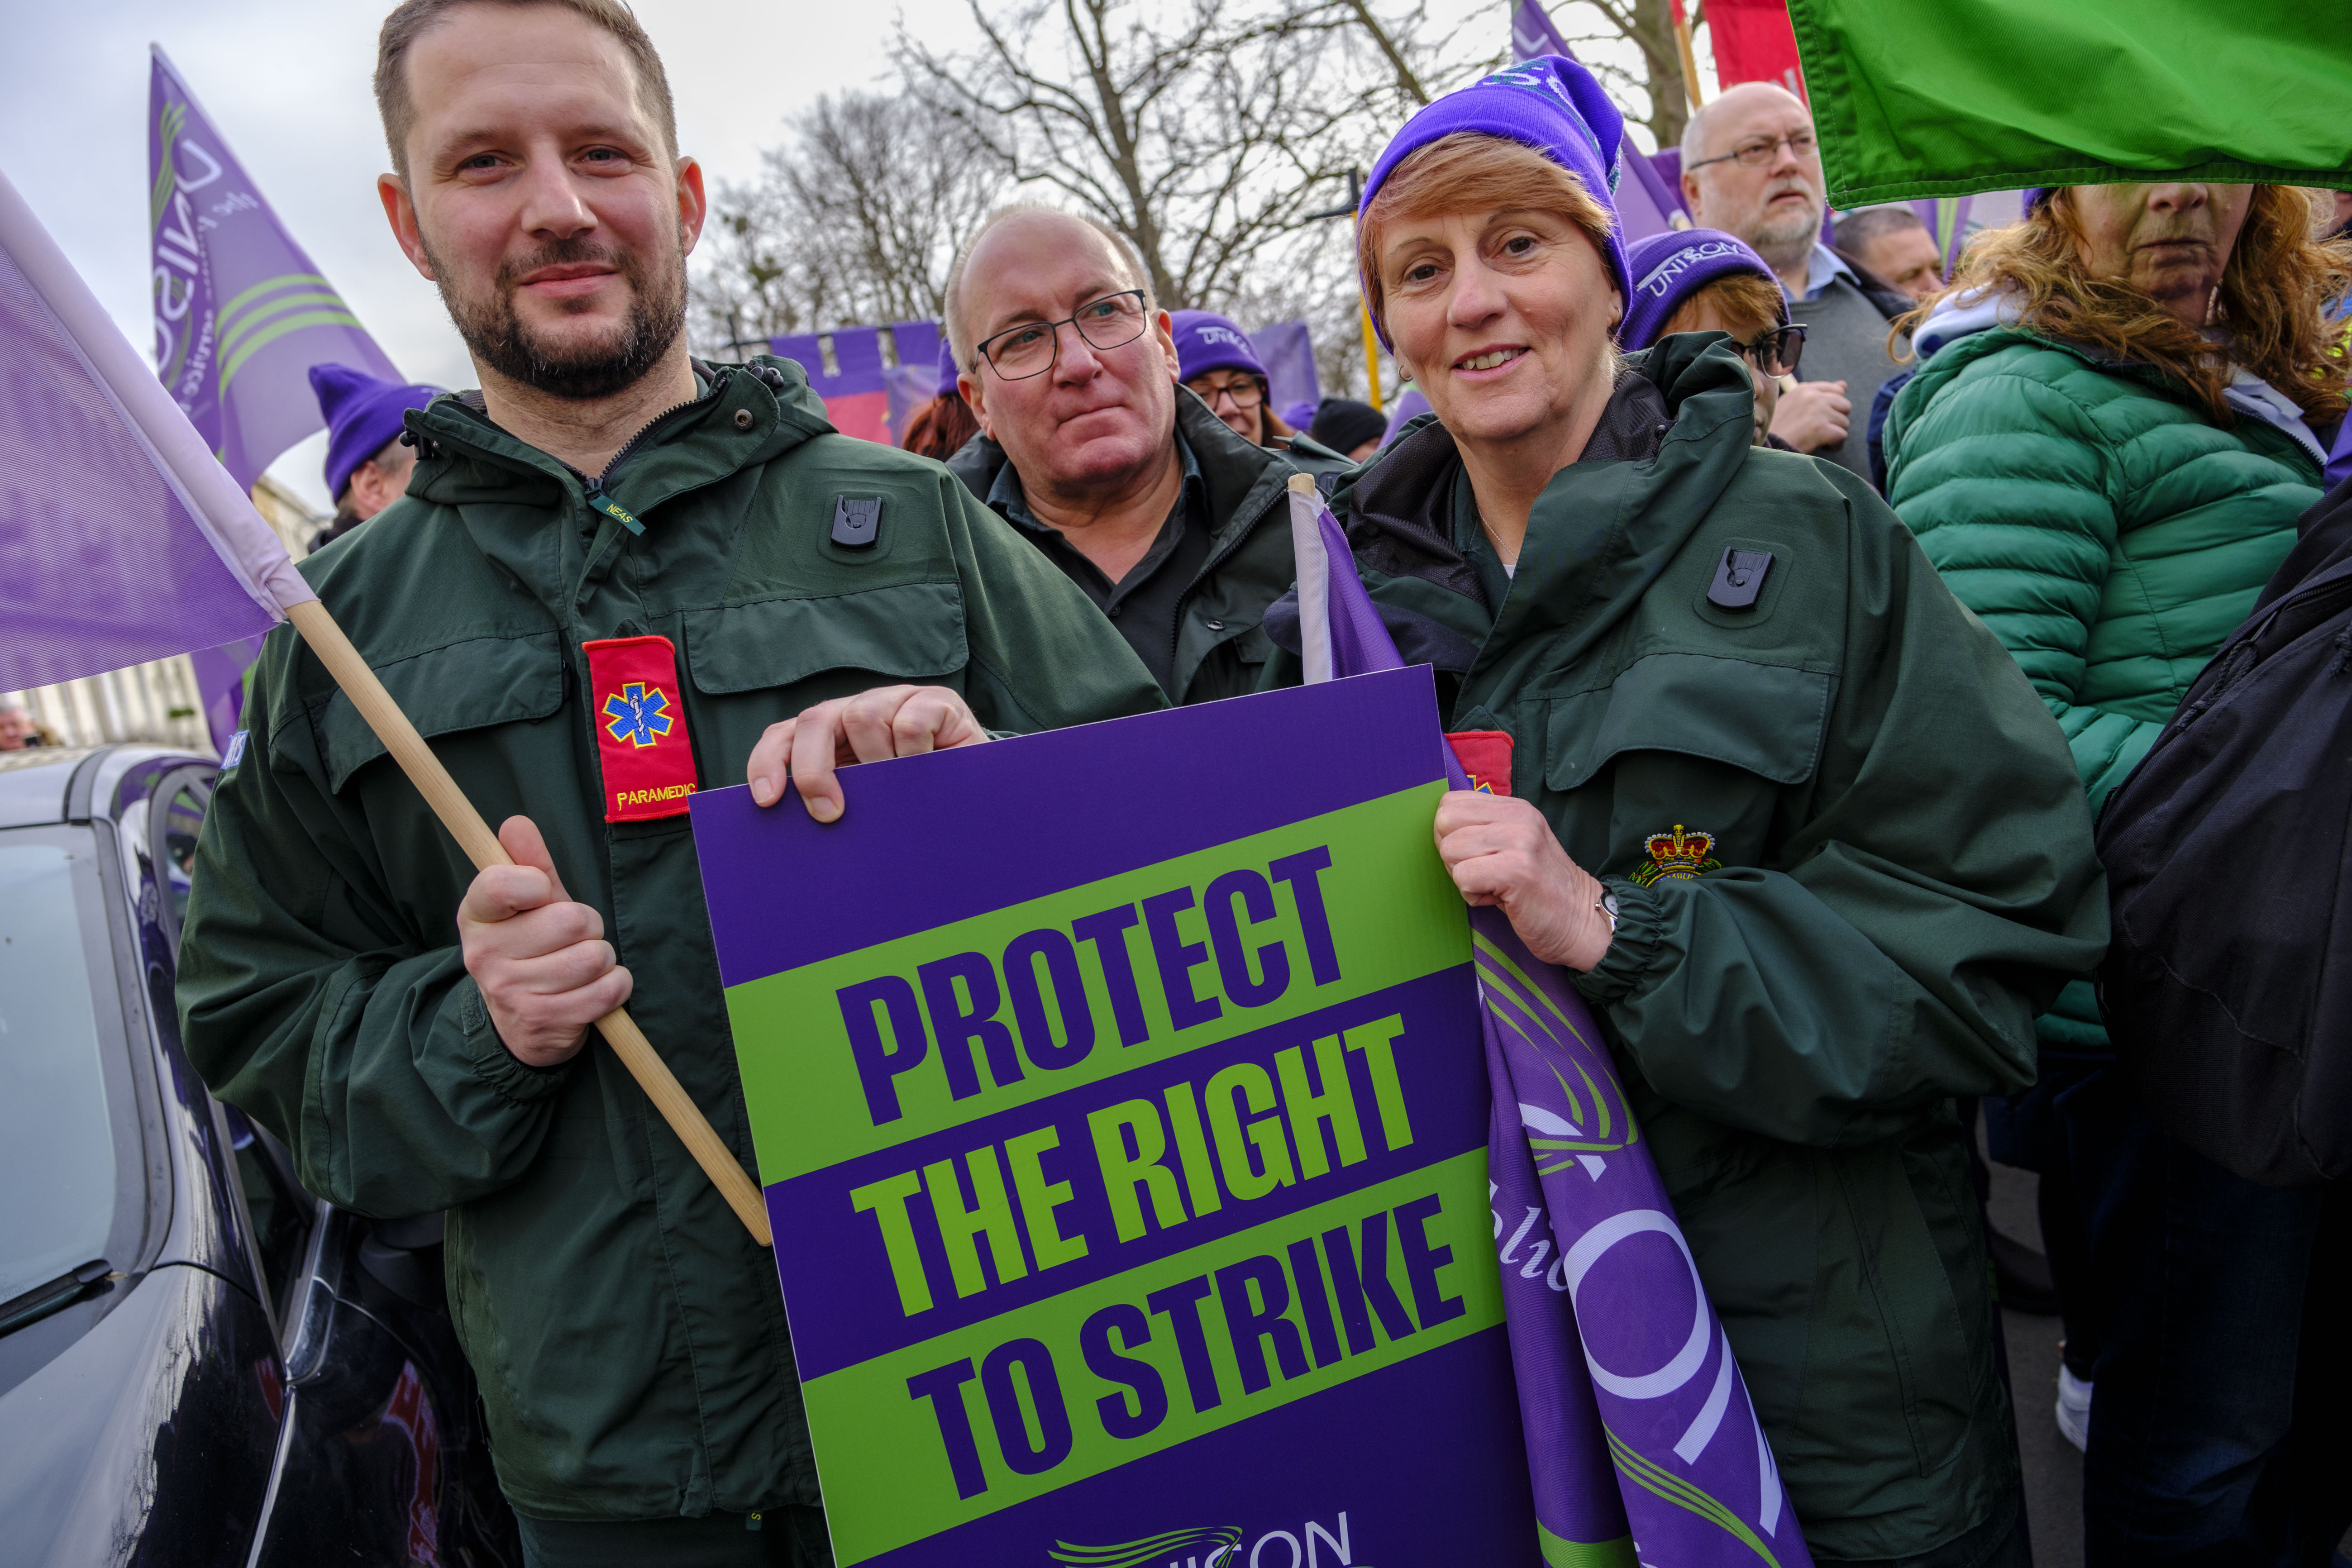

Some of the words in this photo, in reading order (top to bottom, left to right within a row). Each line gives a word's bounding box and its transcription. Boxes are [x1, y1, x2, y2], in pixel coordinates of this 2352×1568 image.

[1649, 241, 1739, 297] UNISON
[606, 504, 633, 523] NEAS
[617, 783, 696, 811] PARAMEDIC
[835, 844, 1342, 1127] PROTECT
[850, 1125, 1089, 1317] THE
[1087, 1013, 1414, 1244] RIGHT
[906, 1337, 1074, 1501] TO
[1080, 1192, 1466, 1439] STRIKE
